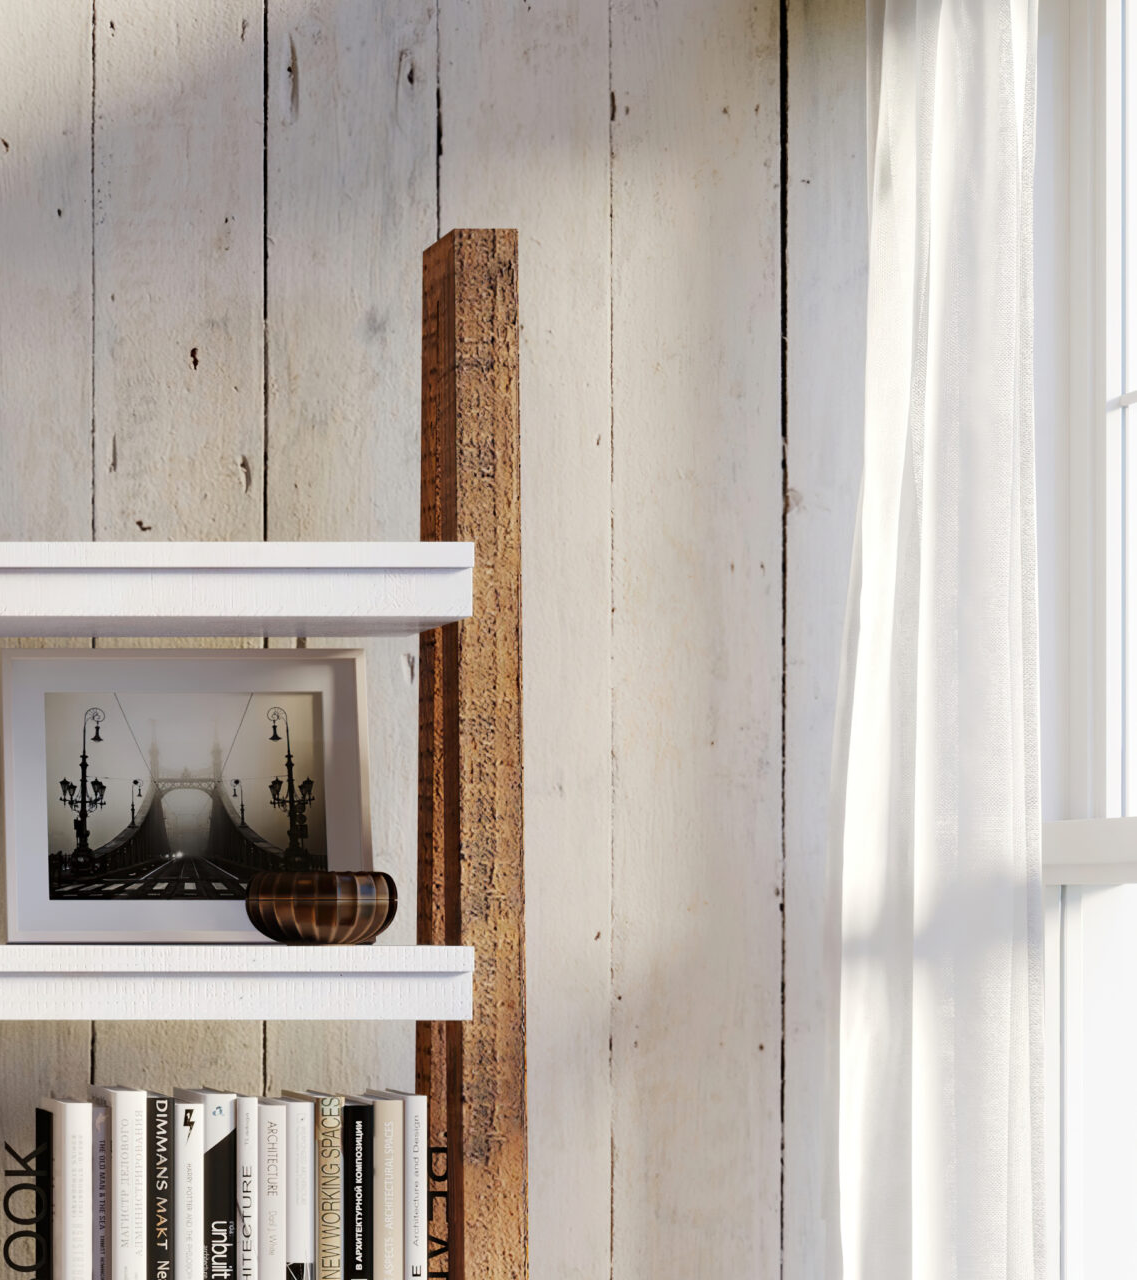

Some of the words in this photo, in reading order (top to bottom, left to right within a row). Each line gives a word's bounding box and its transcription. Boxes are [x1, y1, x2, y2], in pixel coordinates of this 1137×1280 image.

[120, 1118, 131, 1187] ДЕЛОВОГО
[156, 1099, 168, 1190] DIMMANS
[321, 1097, 341, 1159] SPACES
[355, 1120, 364, 1184] КОМПОЗИЦИИ
[383, 1121, 394, 1155] SPACES
[413, 1115, 421, 1153] Design
[185, 1163, 193, 1183] HARRY
[267, 1121, 279, 1197] ARCHITECTURE
[120, 1189, 130, 1248] МАГИСТР
[156, 1197, 168, 1250] MAKT
[185, 1186, 193, 1210] POTTER
[185, 1213, 193, 1227] AND
[321, 1164, 341, 1239] WORKING
[354, 1186, 363, 1262] АРХИТЕКТУРНОЙ
[212, 1220, 233, 1279] unbuilt
[321, 1243, 341, 1280] NEW
[383, 1236, 394, 1275] ASPECTS
